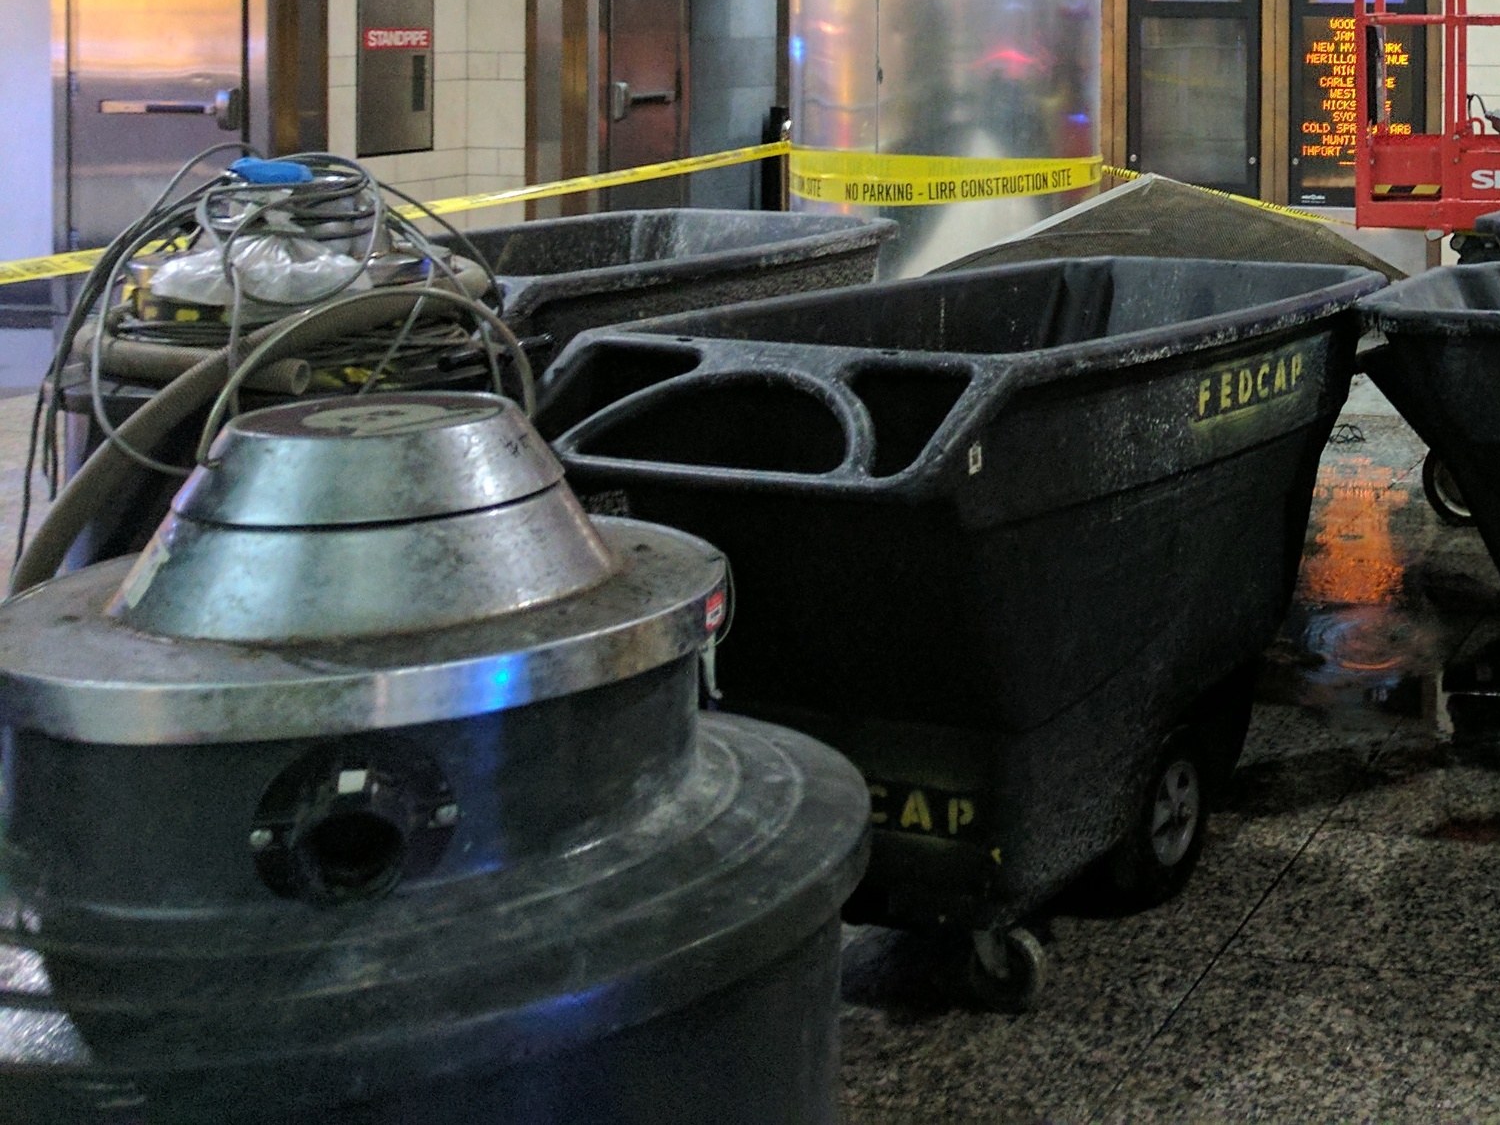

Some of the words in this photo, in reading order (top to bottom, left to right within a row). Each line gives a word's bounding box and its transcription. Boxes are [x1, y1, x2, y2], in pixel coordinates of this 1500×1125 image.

[1329, 18, 1356, 29] WOOD
[367, 29, 429, 47] STANDPIPE
[1312, 42, 1335, 52] NEW
[1340, 42, 1356, 52] HY
[1319, 77, 1355, 87] CARLE
[1328, 89, 1356, 99] WEST
[1302, 122, 1330, 133] COLD
[1389, 123, 1412, 135] ARB
[1322, 134, 1357, 145] HUNTI
[845, 183, 859, 201] NO
[862, 182, 913, 202] PARKING
[928, 181, 957, 200] LIRR
[960, 173, 1049, 198] CONSTRUCTION
[1052, 168, 1073, 188] SITE
[1197, 352, 1303, 417] FEDCAP
[869, 784, 975, 835] CAP
